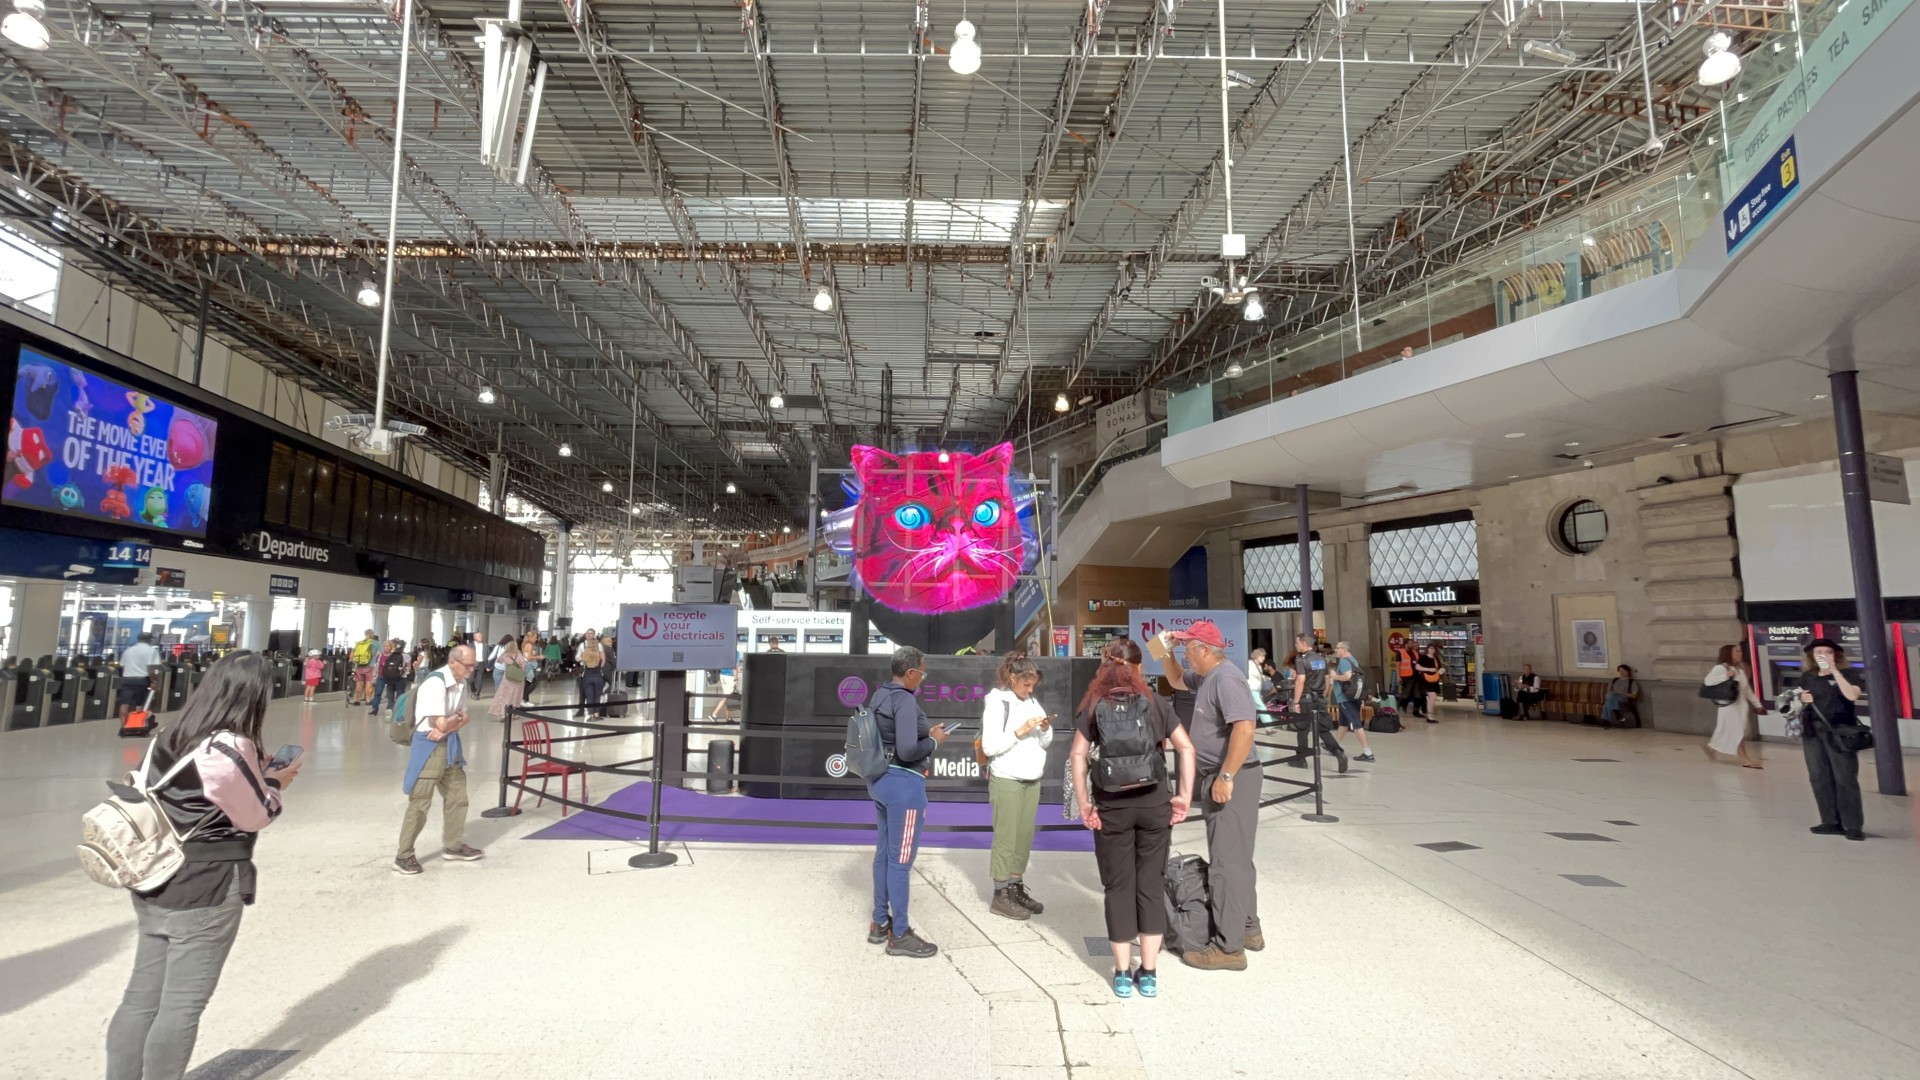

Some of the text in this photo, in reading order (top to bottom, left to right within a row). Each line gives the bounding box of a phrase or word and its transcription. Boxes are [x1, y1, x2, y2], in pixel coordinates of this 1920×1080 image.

[1862, 0, 1888, 26] SA
[1828, 31, 1849, 62] TEA
[1777, 66, 1818, 122] PASTRES
[1745, 123, 1770, 163] COFFEE
[1783, 163, 1792, 182] 3
[1751, 183, 1772, 208] Step free
[1752, 200, 1767, 218] access
[1106, 400, 1137, 417] OLIVER
[1107, 411, 1137, 428] BONAS
[68, 410, 97, 440] THE
[98, 421, 138, 452] MOVIE
[63, 436, 176, 492] OF THE YEAR
[108, 547, 131, 561] 14
[135, 548, 150, 562] 14
[259, 531, 329, 563] Departures
[383, 582, 396, 592] 15
[1387, 586, 1457, 604] WHSmith
[461, 593, 472, 601] 16
[1186, 597, 1200, 607] only
[1256, 595, 1302, 610] WHSmit
[663, 611, 707, 622] recycle
[751, 614, 845, 625] Self-service tickets
[663, 622, 691, 632] your
[1768, 626, 1860, 635] NatWest Nat
[663, 631, 725, 641] electricals
[934, 757, 980, 777] Media
